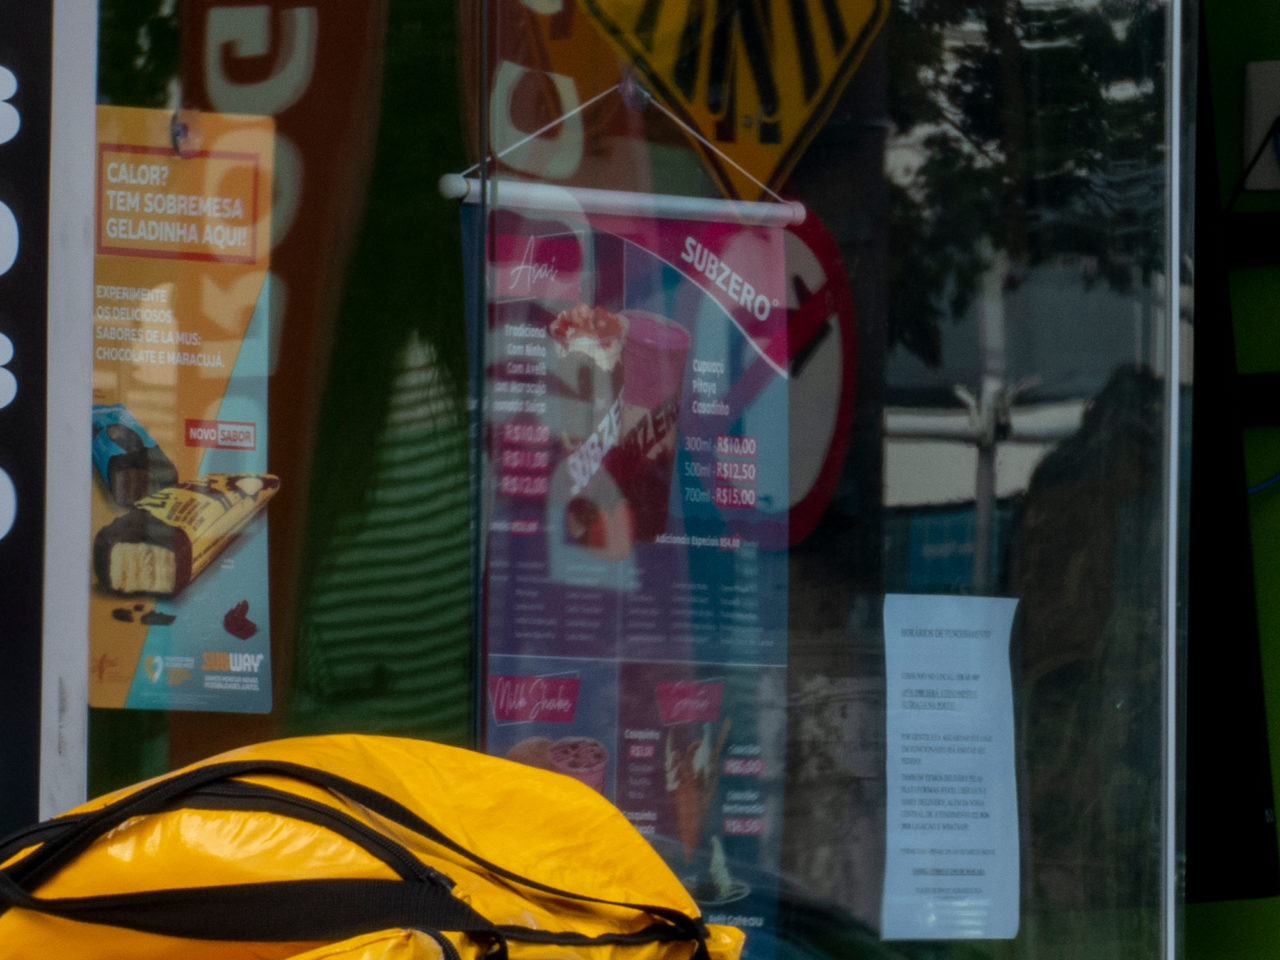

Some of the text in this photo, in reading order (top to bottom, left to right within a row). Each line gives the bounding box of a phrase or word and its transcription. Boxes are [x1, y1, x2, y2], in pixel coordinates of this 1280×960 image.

[106, 163, 169, 186] CALOR?
[106, 189, 244, 219] TEM SOBREMESA
[106, 217, 248, 249] GELADINHA AQUI!
[95, 284, 168, 303] EXPERIMENTE
[95, 305, 173, 323] OS DELICIOSOS
[95, 326, 144, 343] SABORES
[145, 329, 159, 344] DE
[95, 346, 156, 363] CHOCOLATE
[189, 427, 253, 443] NOVO SABOR
[202, 651, 264, 673] SUBWAY
